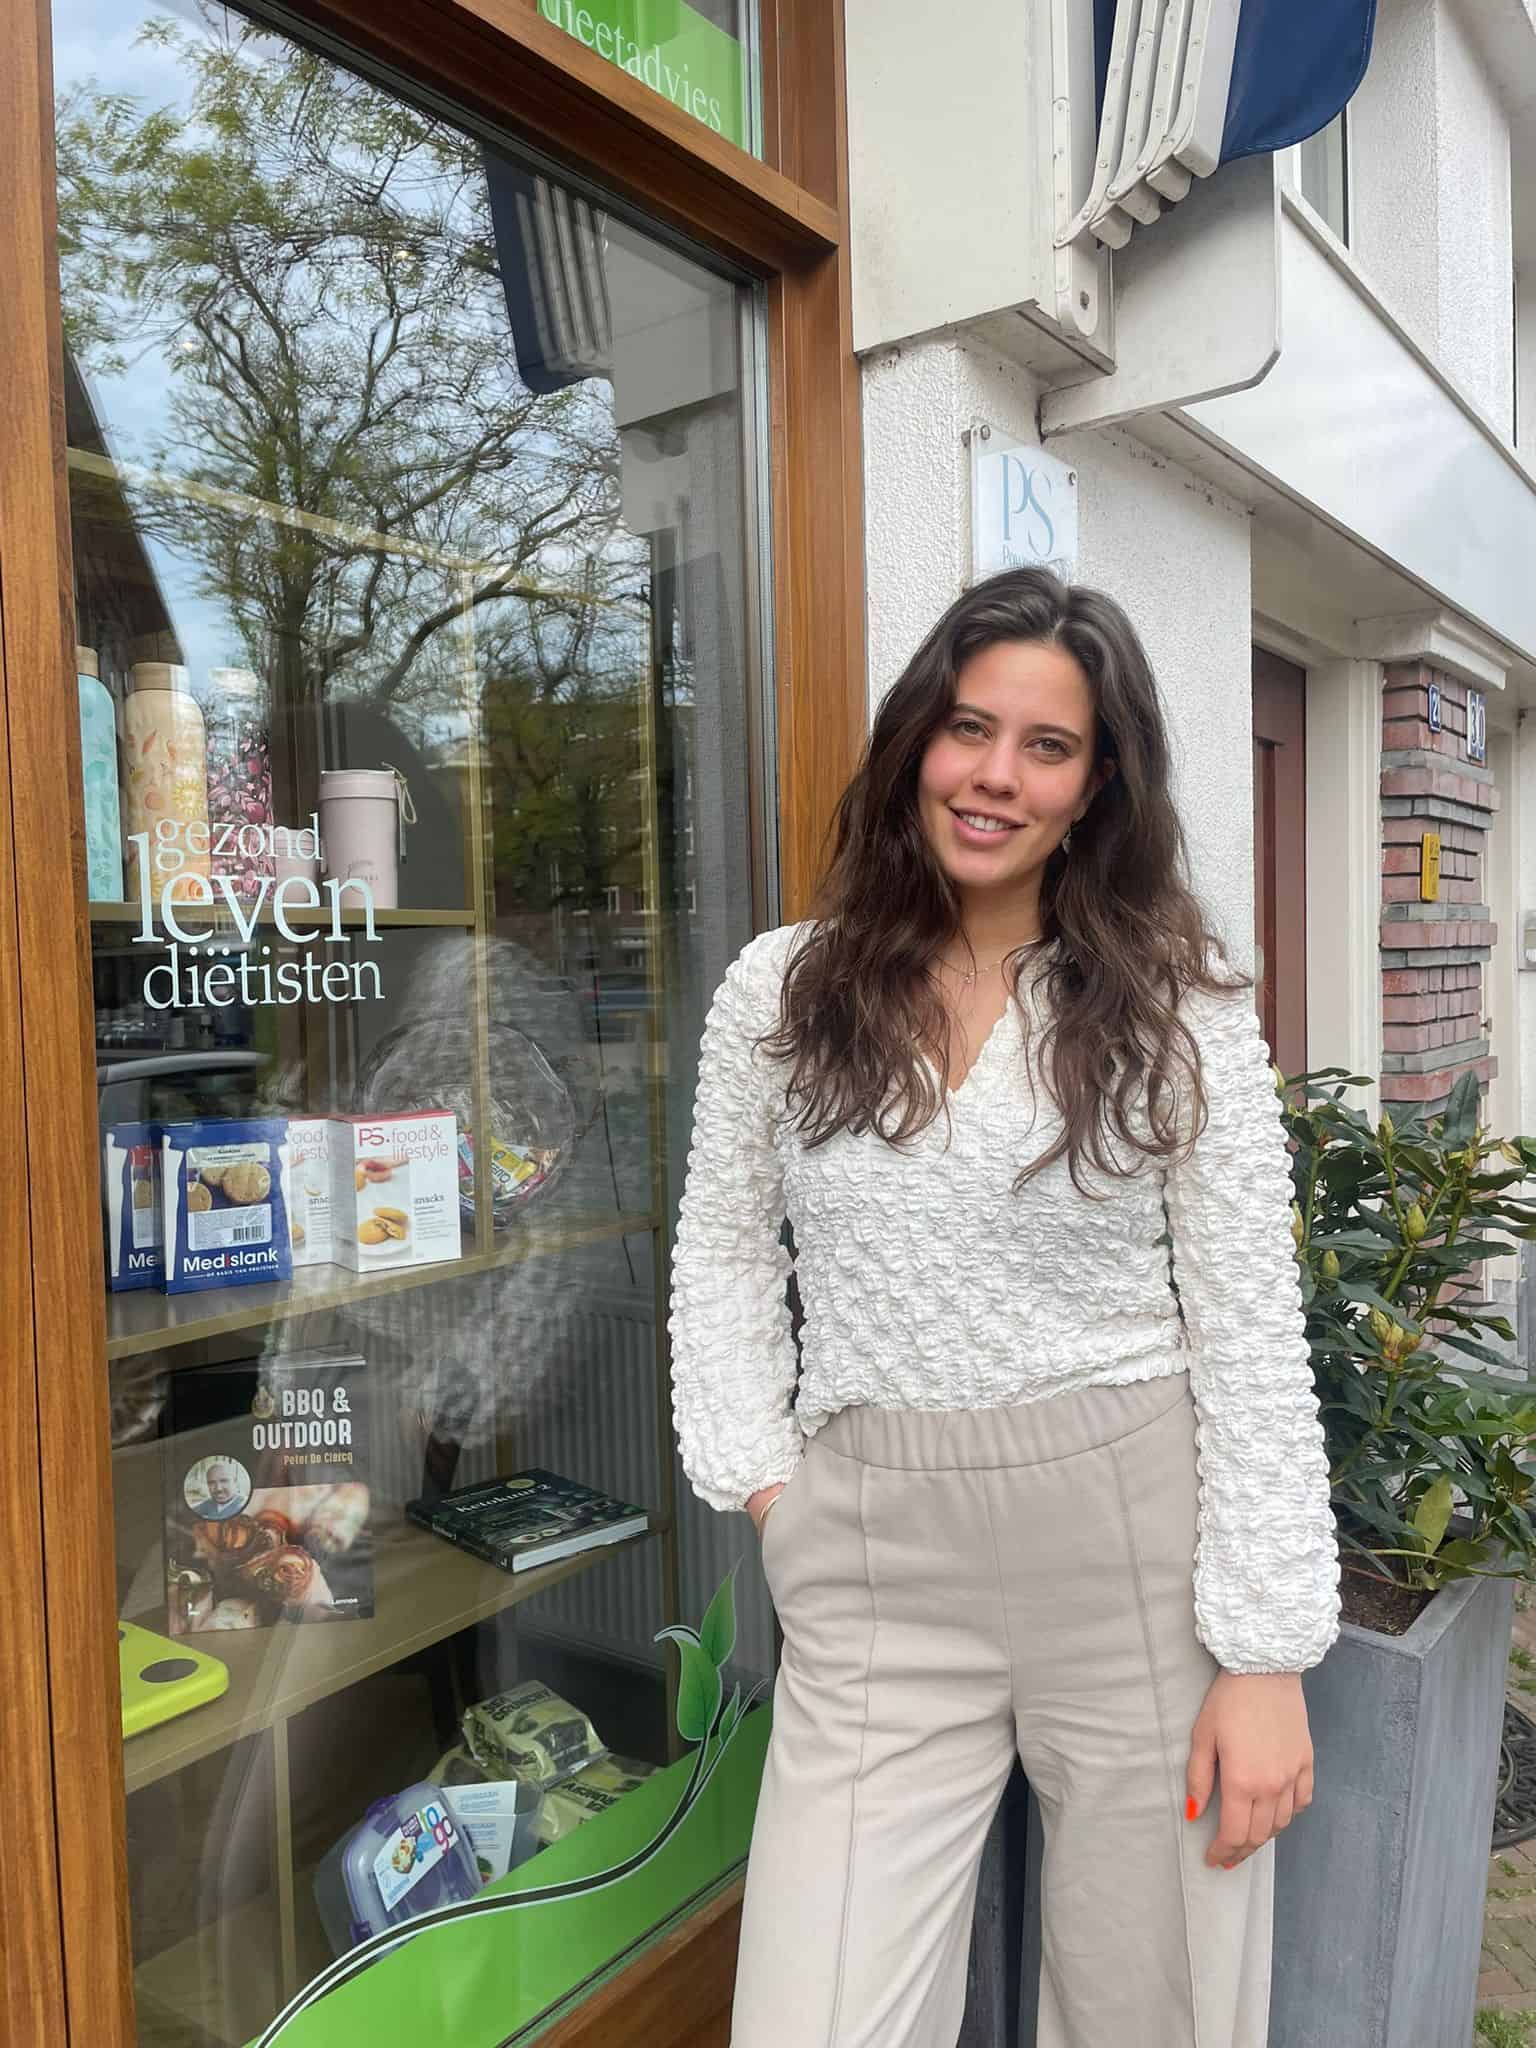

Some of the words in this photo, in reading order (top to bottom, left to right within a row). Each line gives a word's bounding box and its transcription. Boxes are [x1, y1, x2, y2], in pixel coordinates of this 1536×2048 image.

[1001, 454, 1054, 557] PS
[154, 812, 323, 871] gezond
[127, 832, 383, 943] leven
[143, 942, 385, 1009] diëtisten
[392, 1124, 428, 1145] food
[431, 1123, 441, 1141] &
[392, 1141, 449, 1161] lifestyle
[183, 1247, 279, 1273] Medislank
[282, 1388, 325, 1418] BBQ
[333, 1386, 352, 1413] &
[252, 1418, 352, 1450] OUTDOOR
